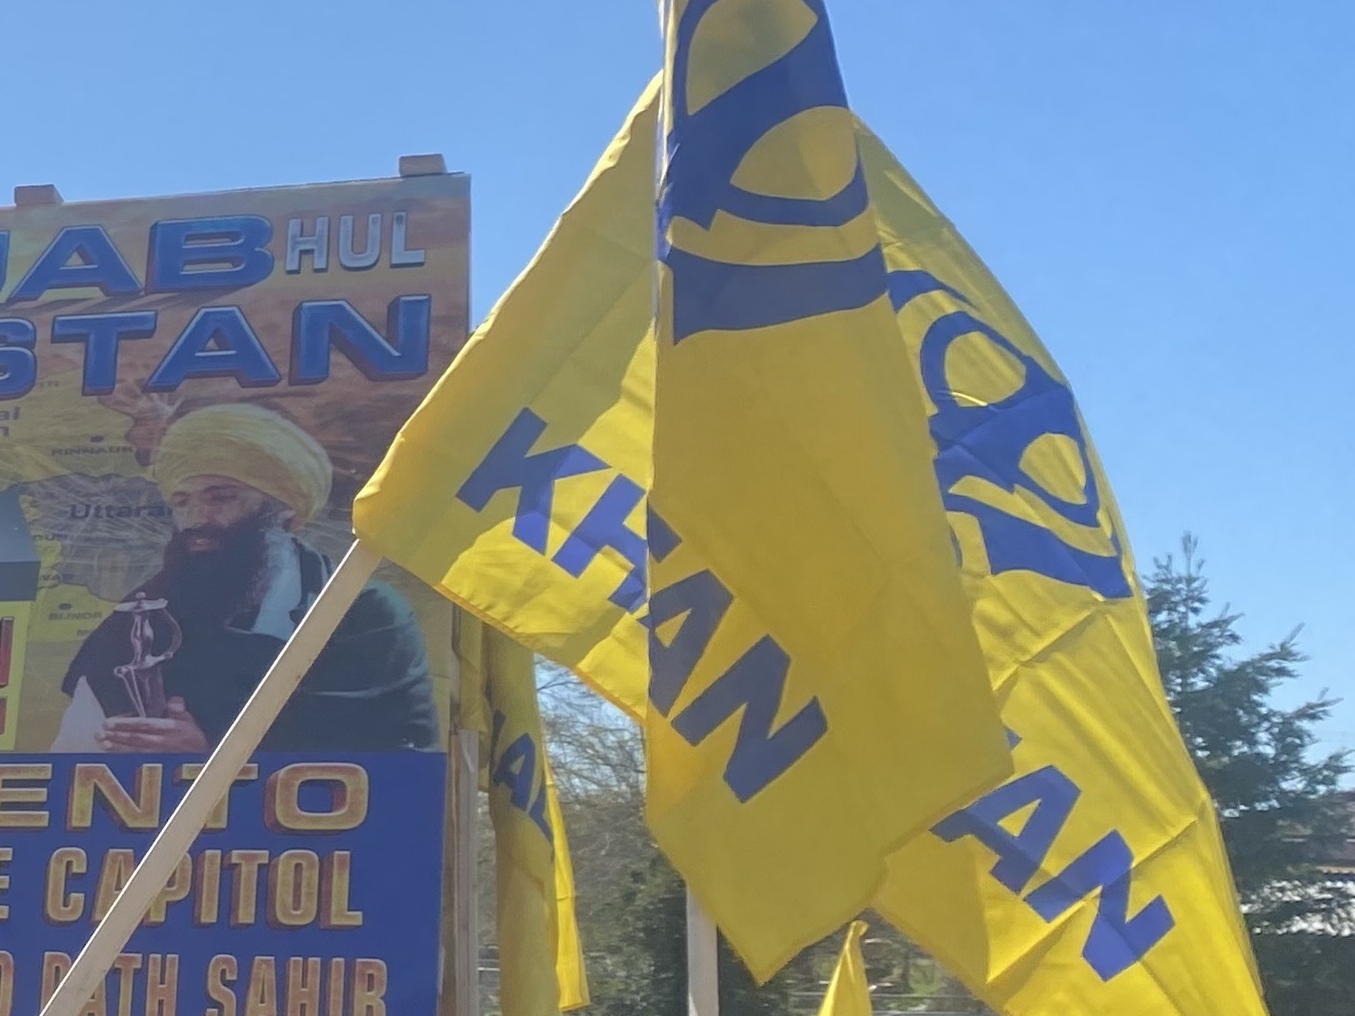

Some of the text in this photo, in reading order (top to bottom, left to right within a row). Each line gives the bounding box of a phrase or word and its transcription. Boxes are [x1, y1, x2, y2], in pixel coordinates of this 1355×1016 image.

[285, 211, 425, 274] HUL
[46, 847, 363, 928] CAPITOL
[929, 729, 1176, 983] AN
